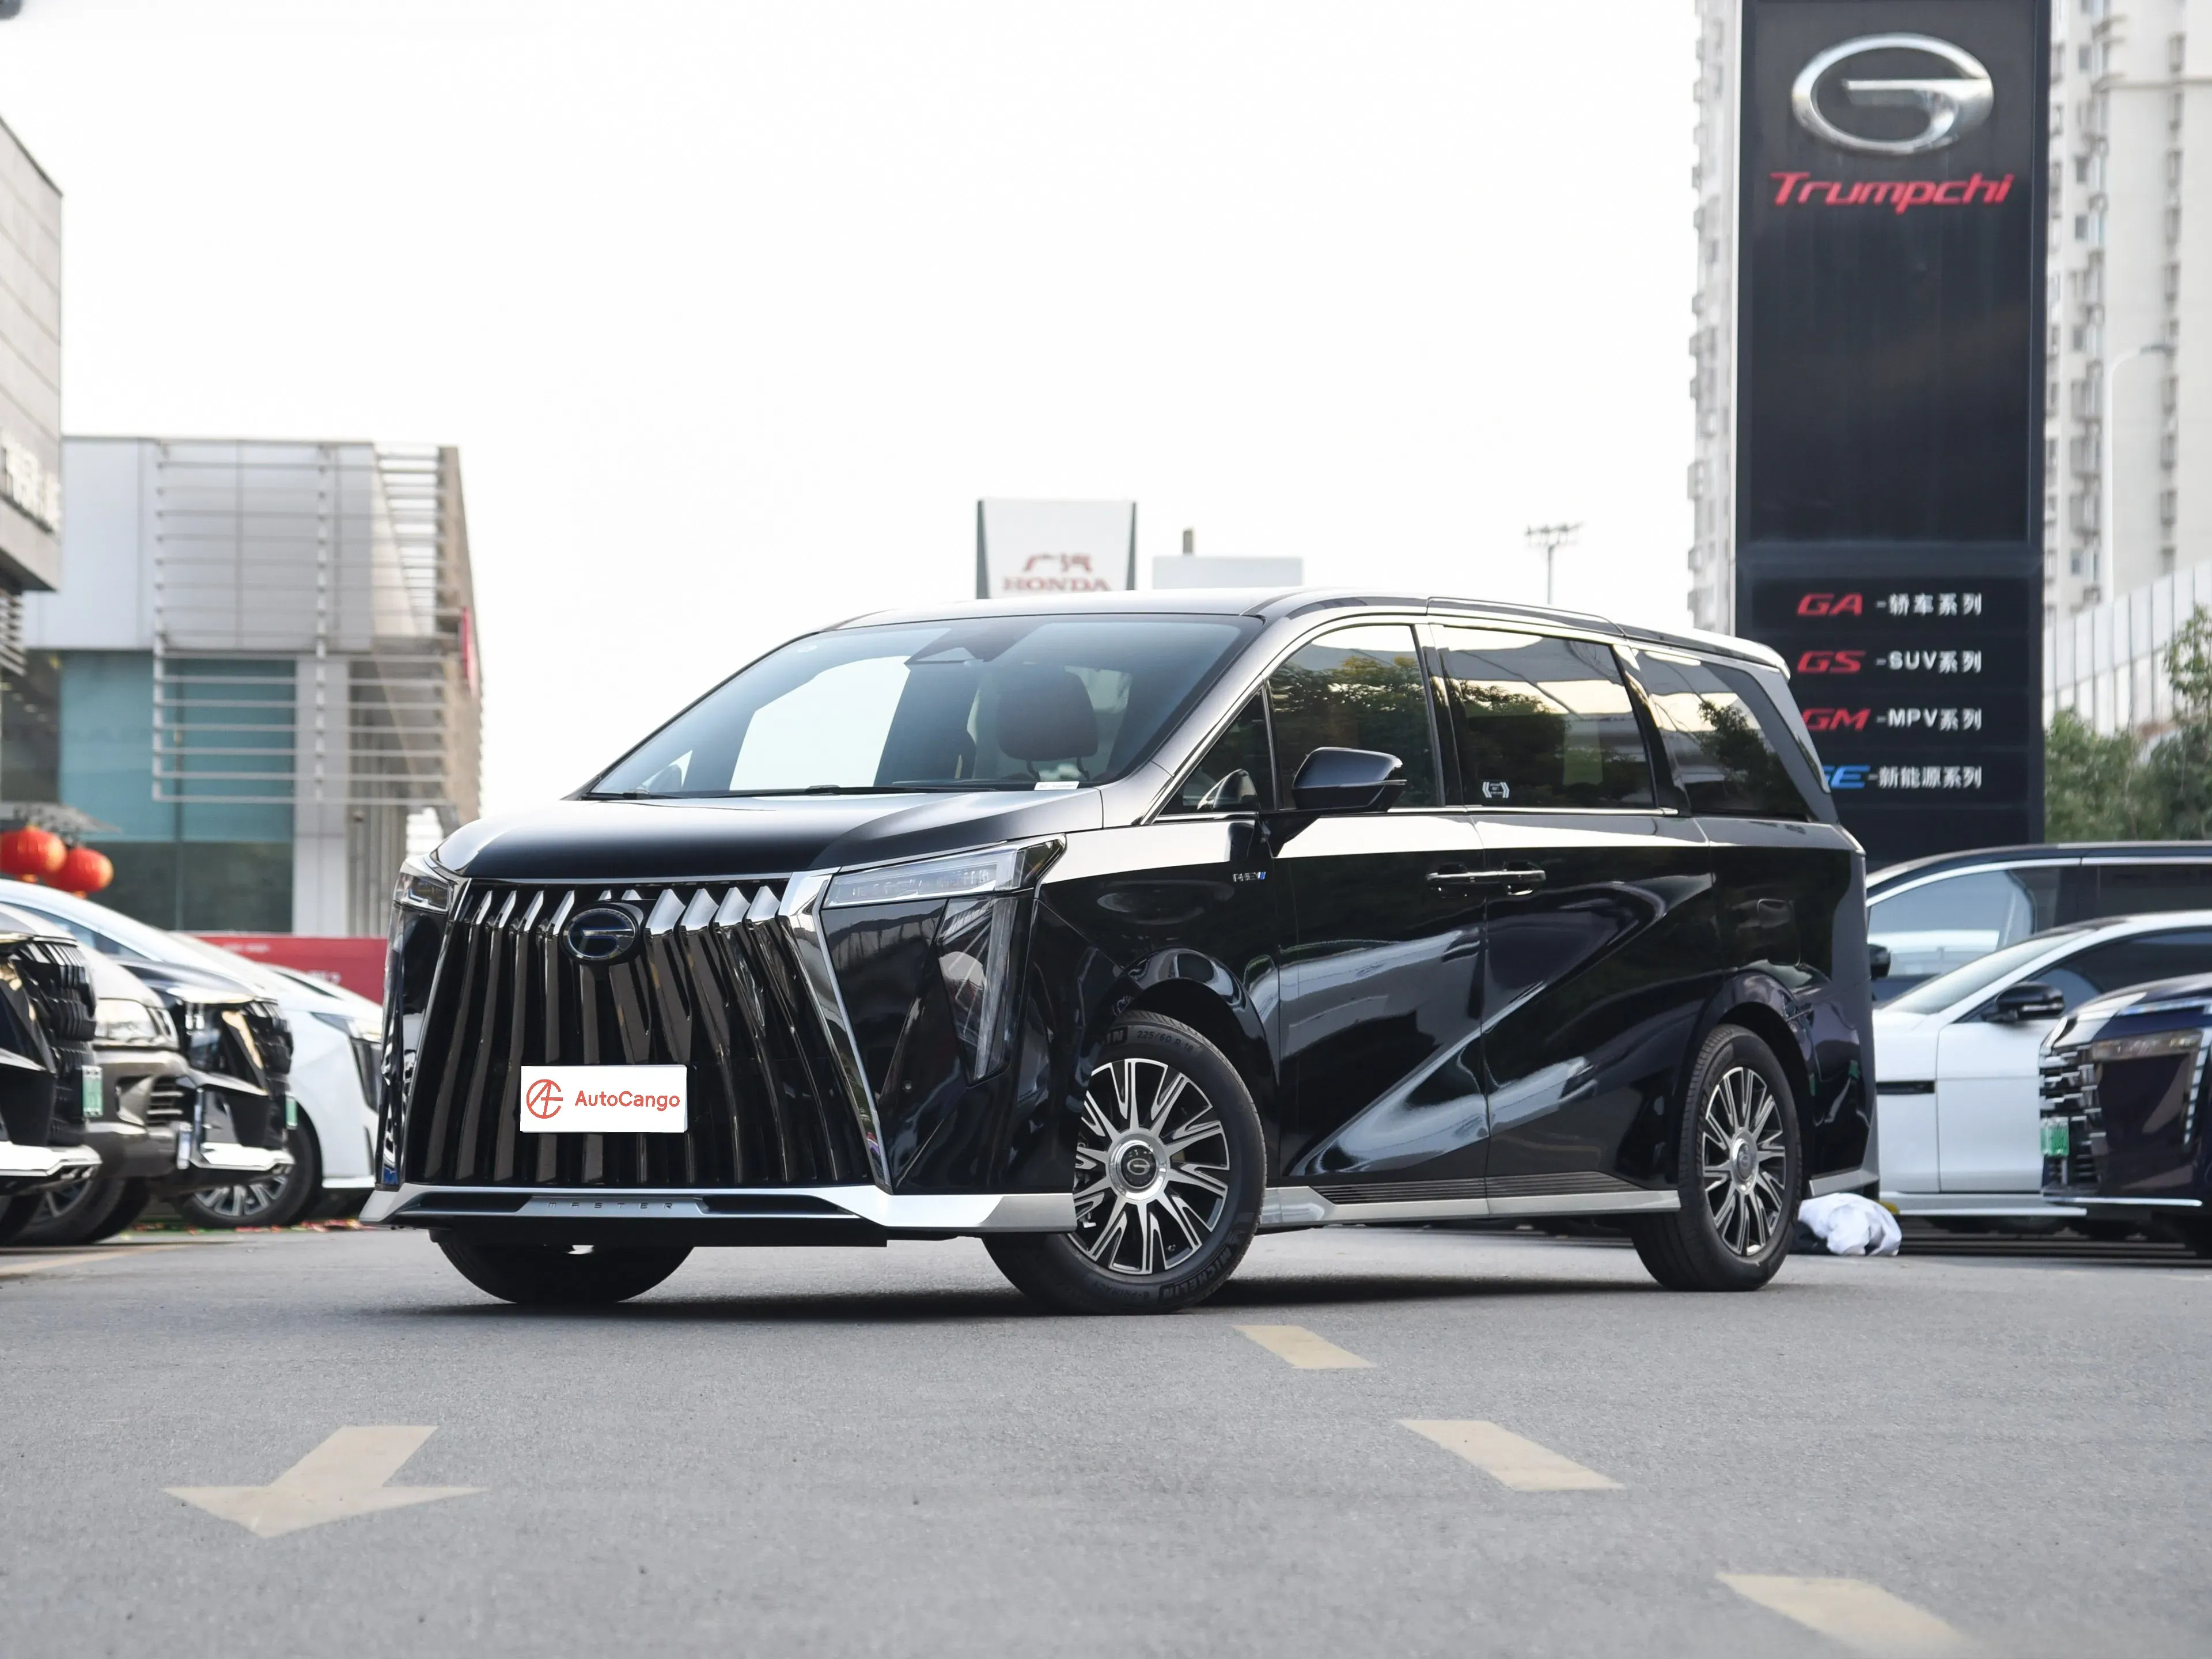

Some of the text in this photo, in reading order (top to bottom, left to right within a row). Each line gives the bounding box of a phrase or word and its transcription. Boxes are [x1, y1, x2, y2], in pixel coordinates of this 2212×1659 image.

[1770, 172, 2015, 215] Trumpchi
[1001, 576, 1112, 592] HONDA
[1797, 592, 1863, 617] GA
[1797, 650, 1866, 674] GS
[1801, 707, 1872, 732] GM
[1137, 1030, 1172, 1043] 225/60
[1174, 1038, 1181, 1047] R
[1162, 1246, 1233, 1299] MICHELIN
